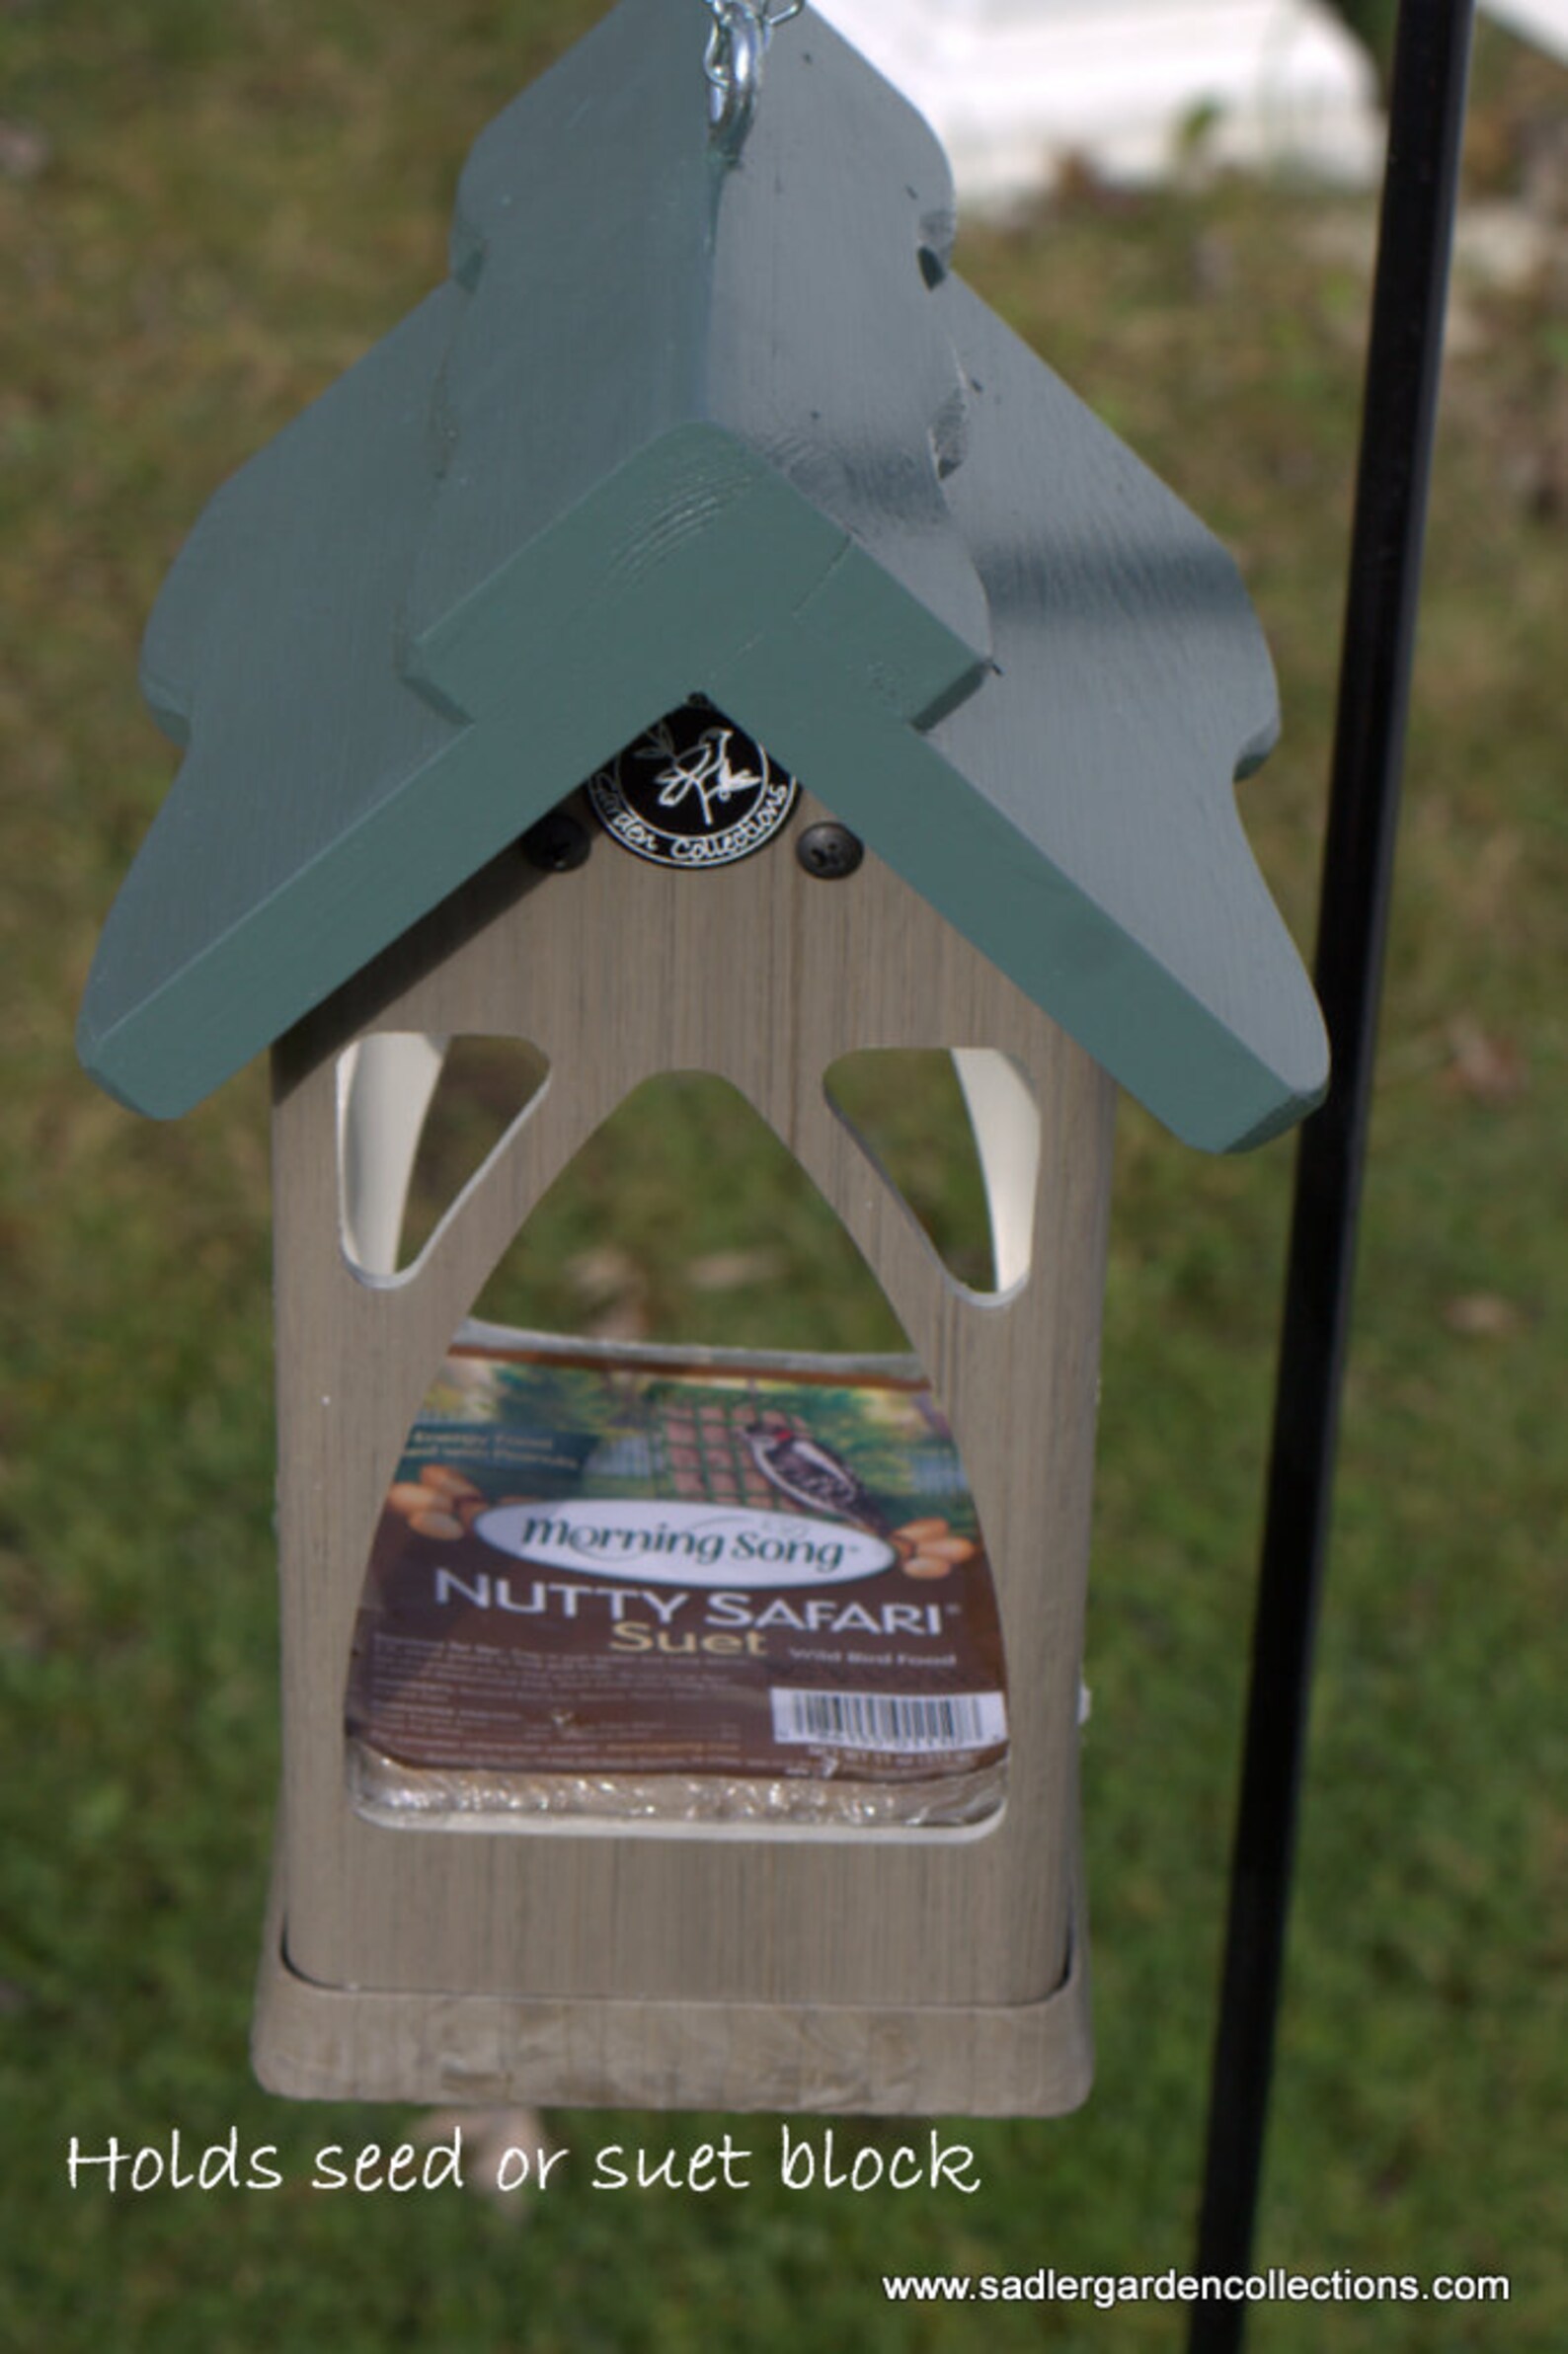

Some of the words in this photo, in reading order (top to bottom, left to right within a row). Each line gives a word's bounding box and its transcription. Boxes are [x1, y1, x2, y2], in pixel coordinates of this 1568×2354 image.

[670, 784, 788, 860] Collections
[731, 1530, 846, 1574] Song
[433, 1568, 689, 1622] NUTTY
[609, 1619, 768, 1658] Suet
[896, 1651, 958, 1667] Food
